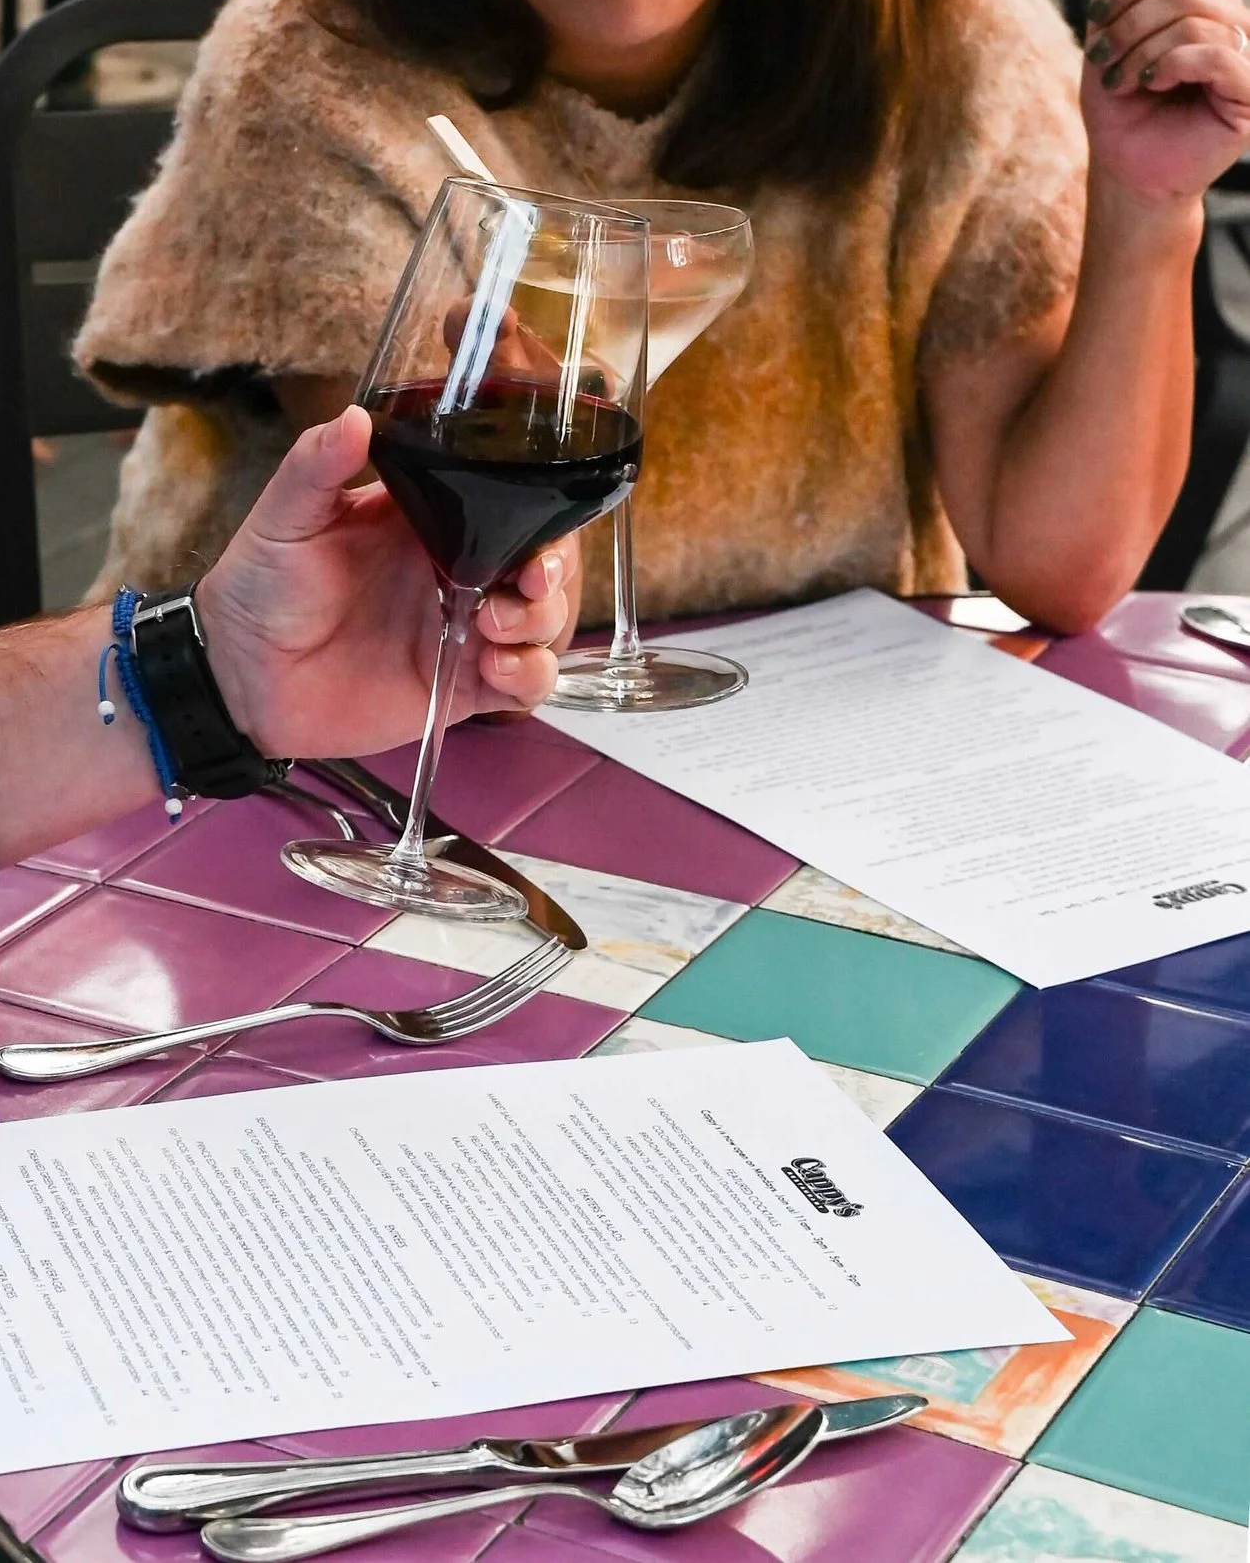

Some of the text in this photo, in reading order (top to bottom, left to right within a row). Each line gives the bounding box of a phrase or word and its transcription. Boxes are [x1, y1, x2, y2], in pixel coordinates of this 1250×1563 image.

[1151, 882, 1248, 910] Cappy's
[697, 1108, 726, 1130] Cappy's
[720, 1134, 737, 1146] now
[730, 1146, 750, 1160] open
[742, 1159, 757, 1168] on
[773, 1193, 791, 1206] Join
[782, 1205, 799, 1215] us!
[791, 1214, 816, 1231] 11am
[810, 1236, 829, 1250] 3pm
[826, 1254, 848, 1268] 5pm
[843, 1273, 865, 1287] 9pm
[790, 1156, 865, 1218] Cappy's
